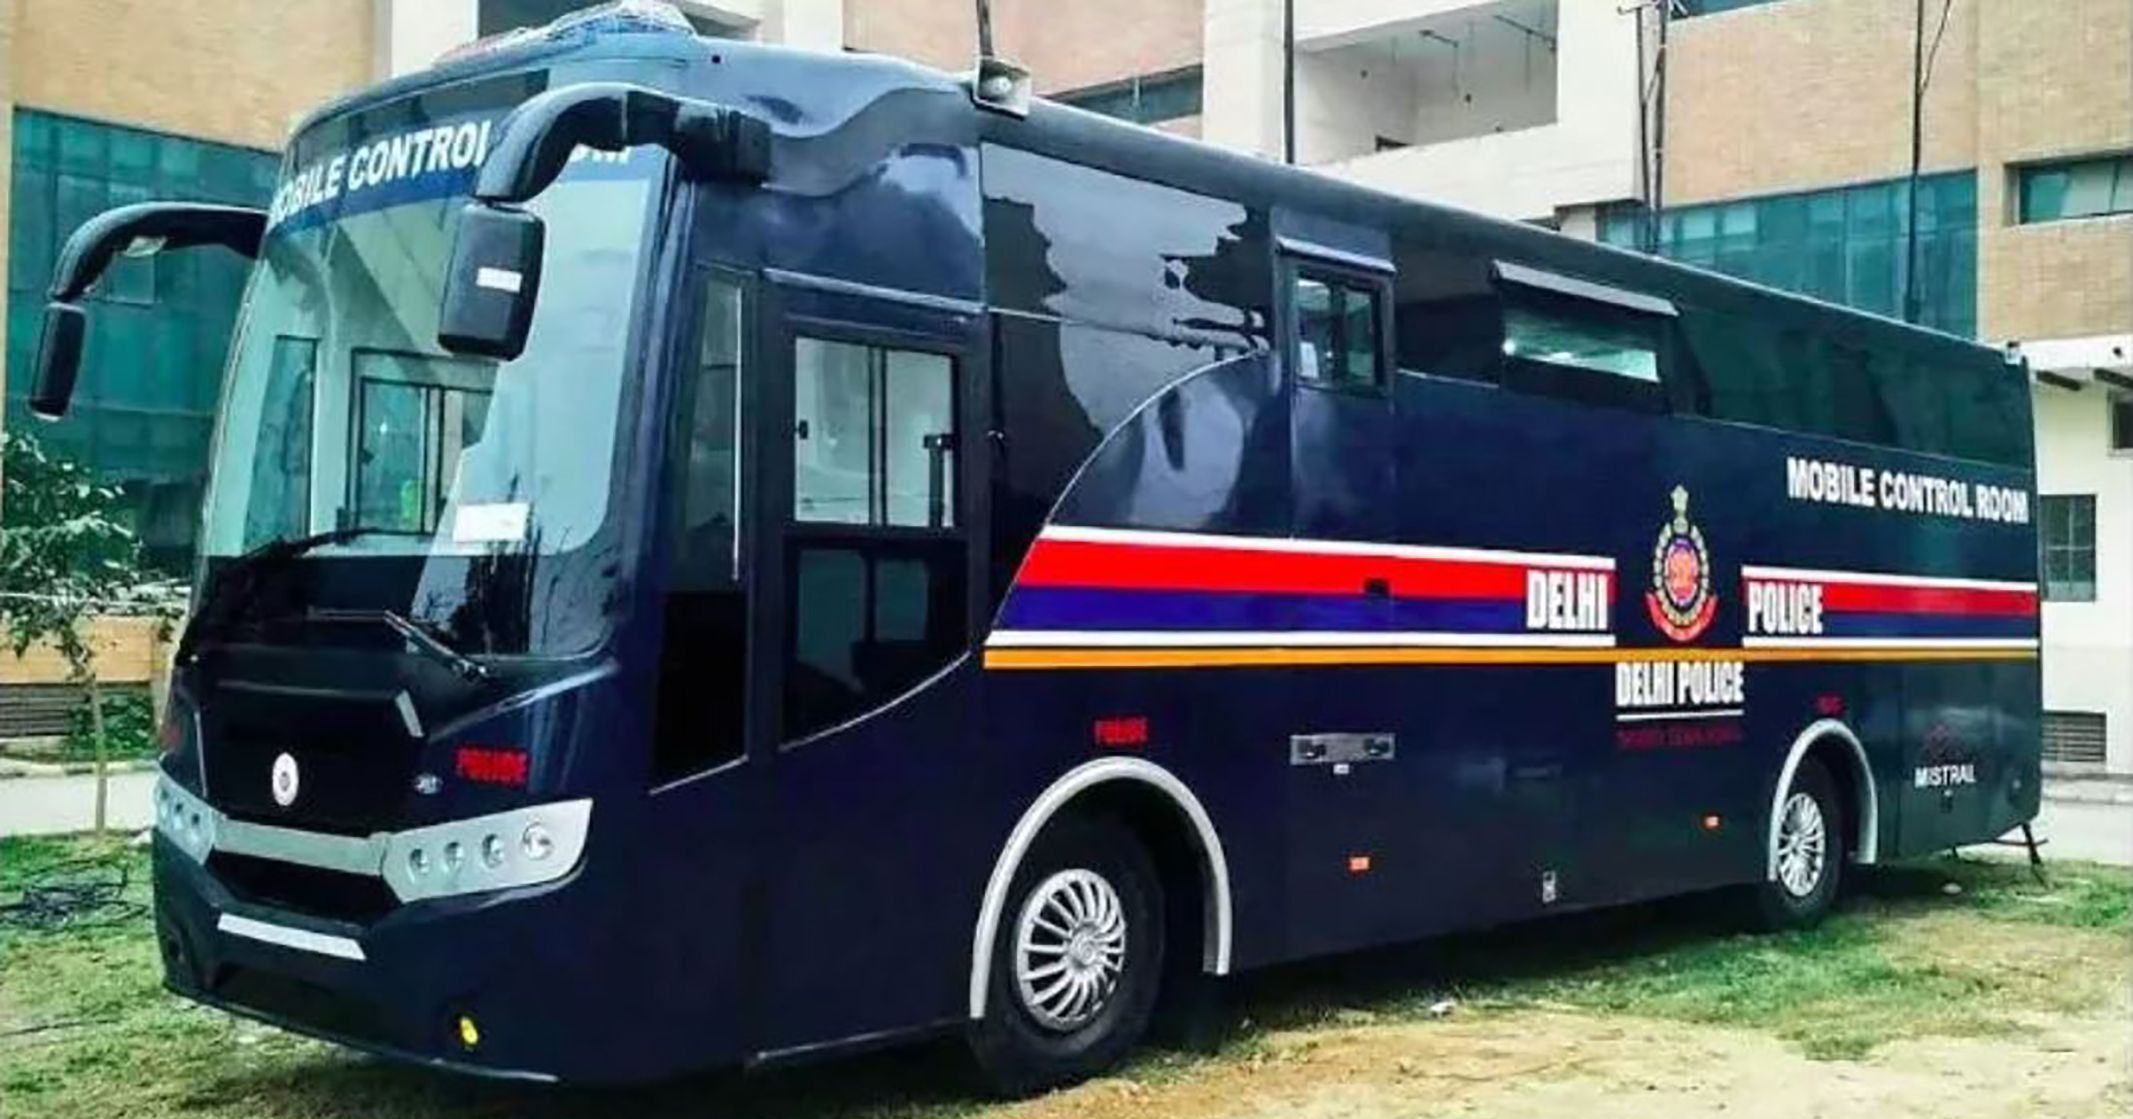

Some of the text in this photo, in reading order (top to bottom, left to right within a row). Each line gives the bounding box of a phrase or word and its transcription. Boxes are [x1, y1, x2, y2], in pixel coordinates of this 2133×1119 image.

[1787, 456, 2030, 524] MOBILE CONTROL ROOM
[1527, 569, 1823, 634] DELHI POLICE
[1616, 661, 1745, 707] DELHI POLICE
[1914, 764, 1977, 788] MISTRAL
